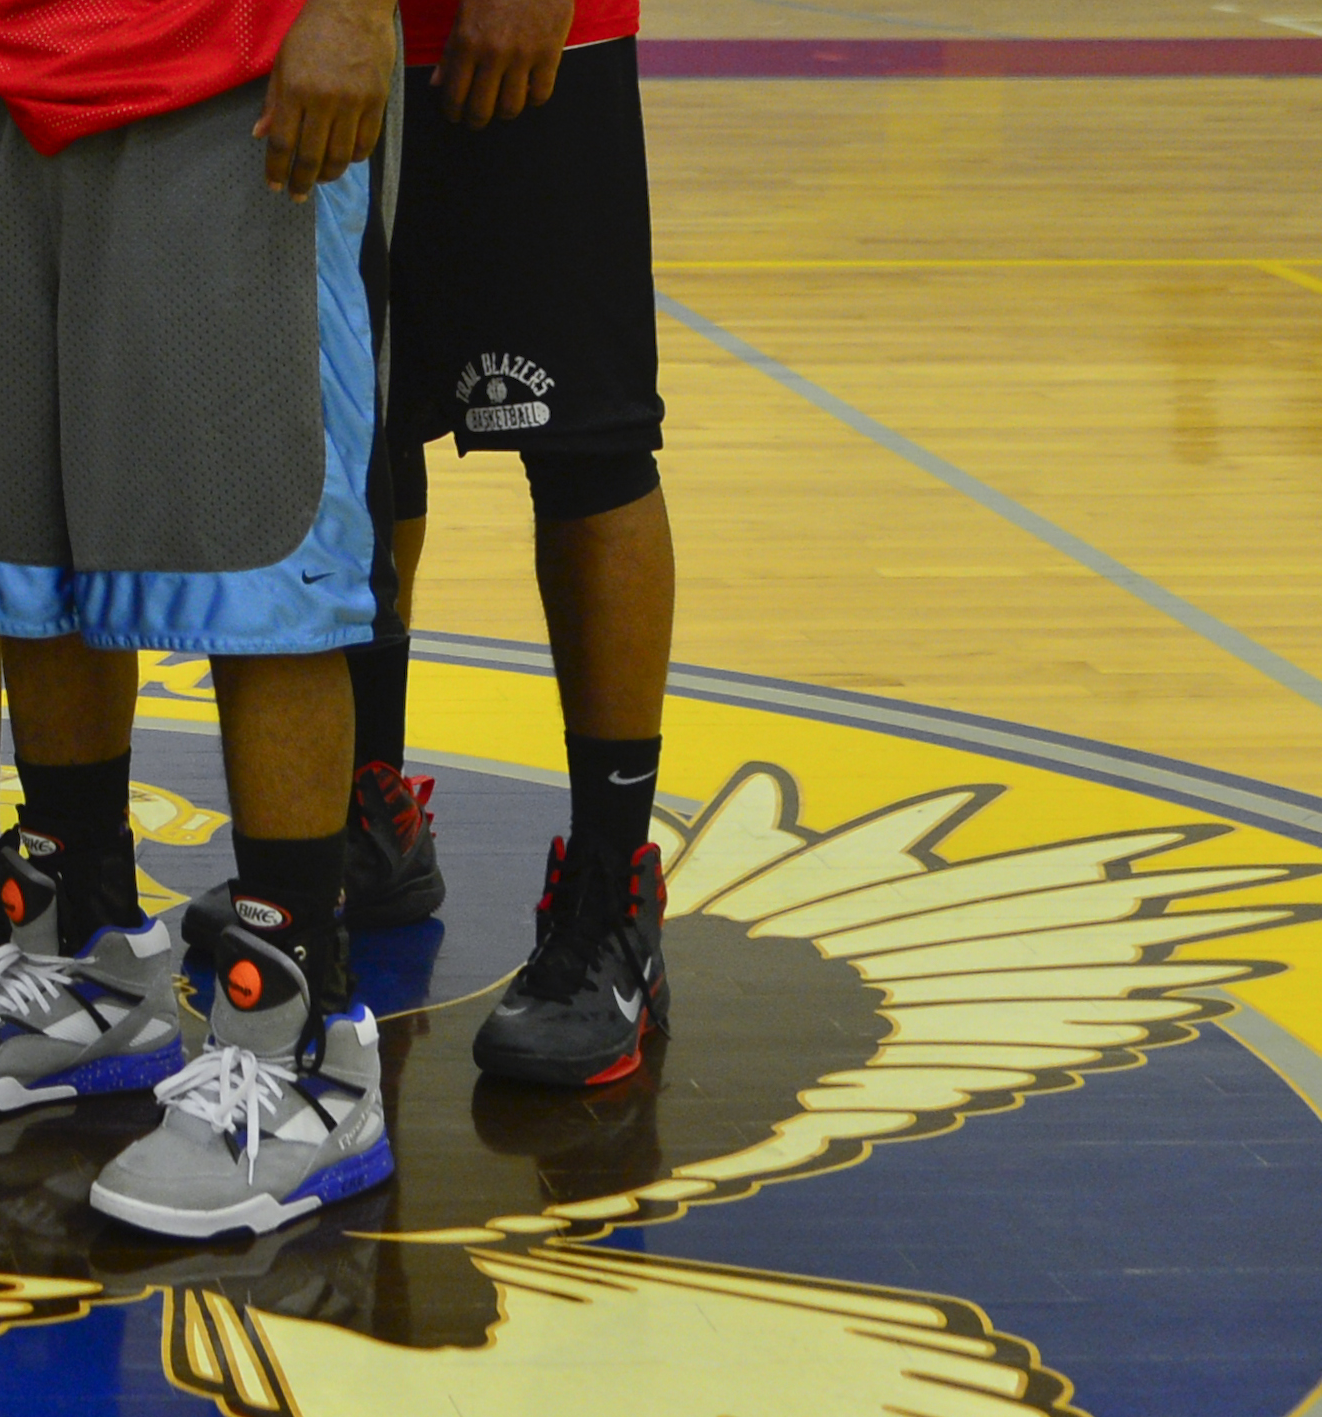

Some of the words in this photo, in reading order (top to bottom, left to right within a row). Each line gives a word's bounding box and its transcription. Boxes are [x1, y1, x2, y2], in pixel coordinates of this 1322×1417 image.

[481, 352, 556, 397] BLAZERS
[471, 402, 542, 431] BASKETBALL
[238, 902, 277, 924] BIKE
